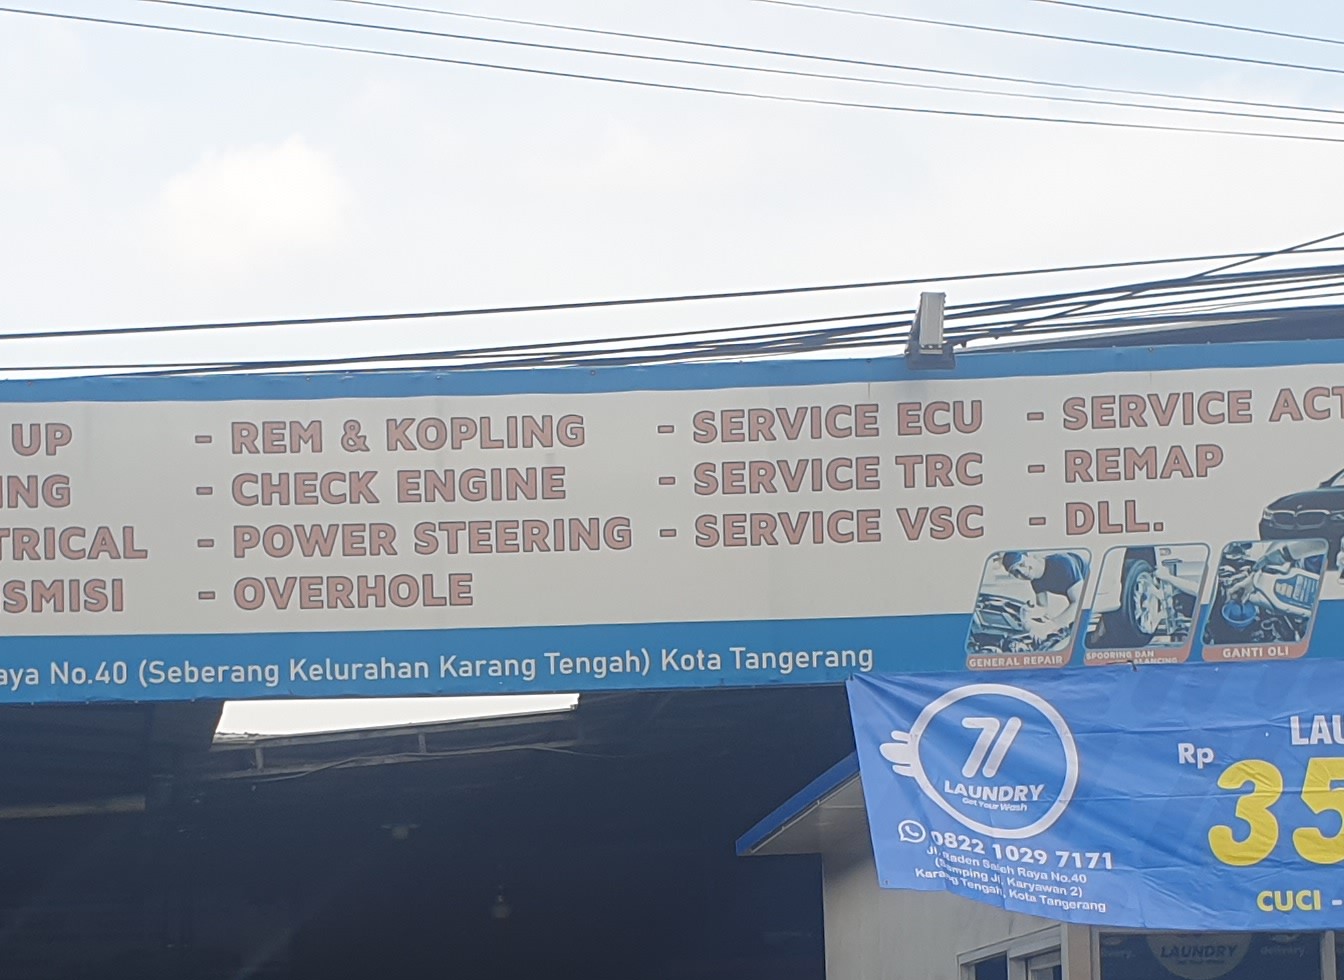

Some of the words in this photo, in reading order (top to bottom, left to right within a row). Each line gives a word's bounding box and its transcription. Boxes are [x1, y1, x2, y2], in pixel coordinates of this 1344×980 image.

[692, 403, 880, 445] SERVICE
[896, 399, 984, 438] ECU
[1062, 389, 1254, 431] SERVICE
[11, 421, 73, 457] UP
[230, 420, 323, 455] REM
[340, 419, 370, 453] &
[385, 413, 586, 452] KOPLING
[692, 455, 881, 497] SERVICE
[895, 452, 985, 489] TRC
[1064, 443, 1225, 484] REMAP
[231, 470, 380, 506] CHECK
[396, 466, 567, 504] ENGINE
[693, 508, 882, 549] SERVICE
[896, 504, 985, 540] VSC
[1064, 499, 1164, 537] DLL.
[233, 522, 398, 559] POWER
[413, 516, 633, 555] STEERING
[233, 572, 474, 611] OVERHOLE
[49, 660, 128, 687] No.40
[137, 656, 280, 688] (Seberang
[289, 656, 429, 682] Kelurahan
[438, 653, 537, 682] Karang
[544, 648, 652, 678] Tengah)
[659, 647, 722, 673] Kota
[729, 645, 874, 675] Tangerang
[968, 656, 1022, 668] GENERAL
[1023, 655, 1064, 666] REPAIR
[1085, 650, 1133, 662] SPOORING
[1134, 650, 1155, 659] DAN
[1222, 647, 1259, 660] GANTI
[1263, 645, 1289, 658] OLI
[1178, 743, 1215, 770] Rp
[944, 779, 1045, 802] LAUNDRY
[978, 800, 1000, 811] Your
[1000, 802, 1028, 812] Wash
[930, 830, 986, 856] 0822
[992, 843, 1048, 866] 1029
[1055, 850, 1114, 870] 7171
[1007, 877, 1068, 897] Karyawan
[1070, 885, 1083, 899] 2)
[1017, 867, 1049, 884] Raya
[1051, 872, 1088, 885] No.40
[1009, 888, 1037, 904] Kota
[1039, 894, 1106, 913] Tangerang
[1256, 887, 1321, 913] CUCI
[1160, 944, 1238, 958] LAUNDRY
